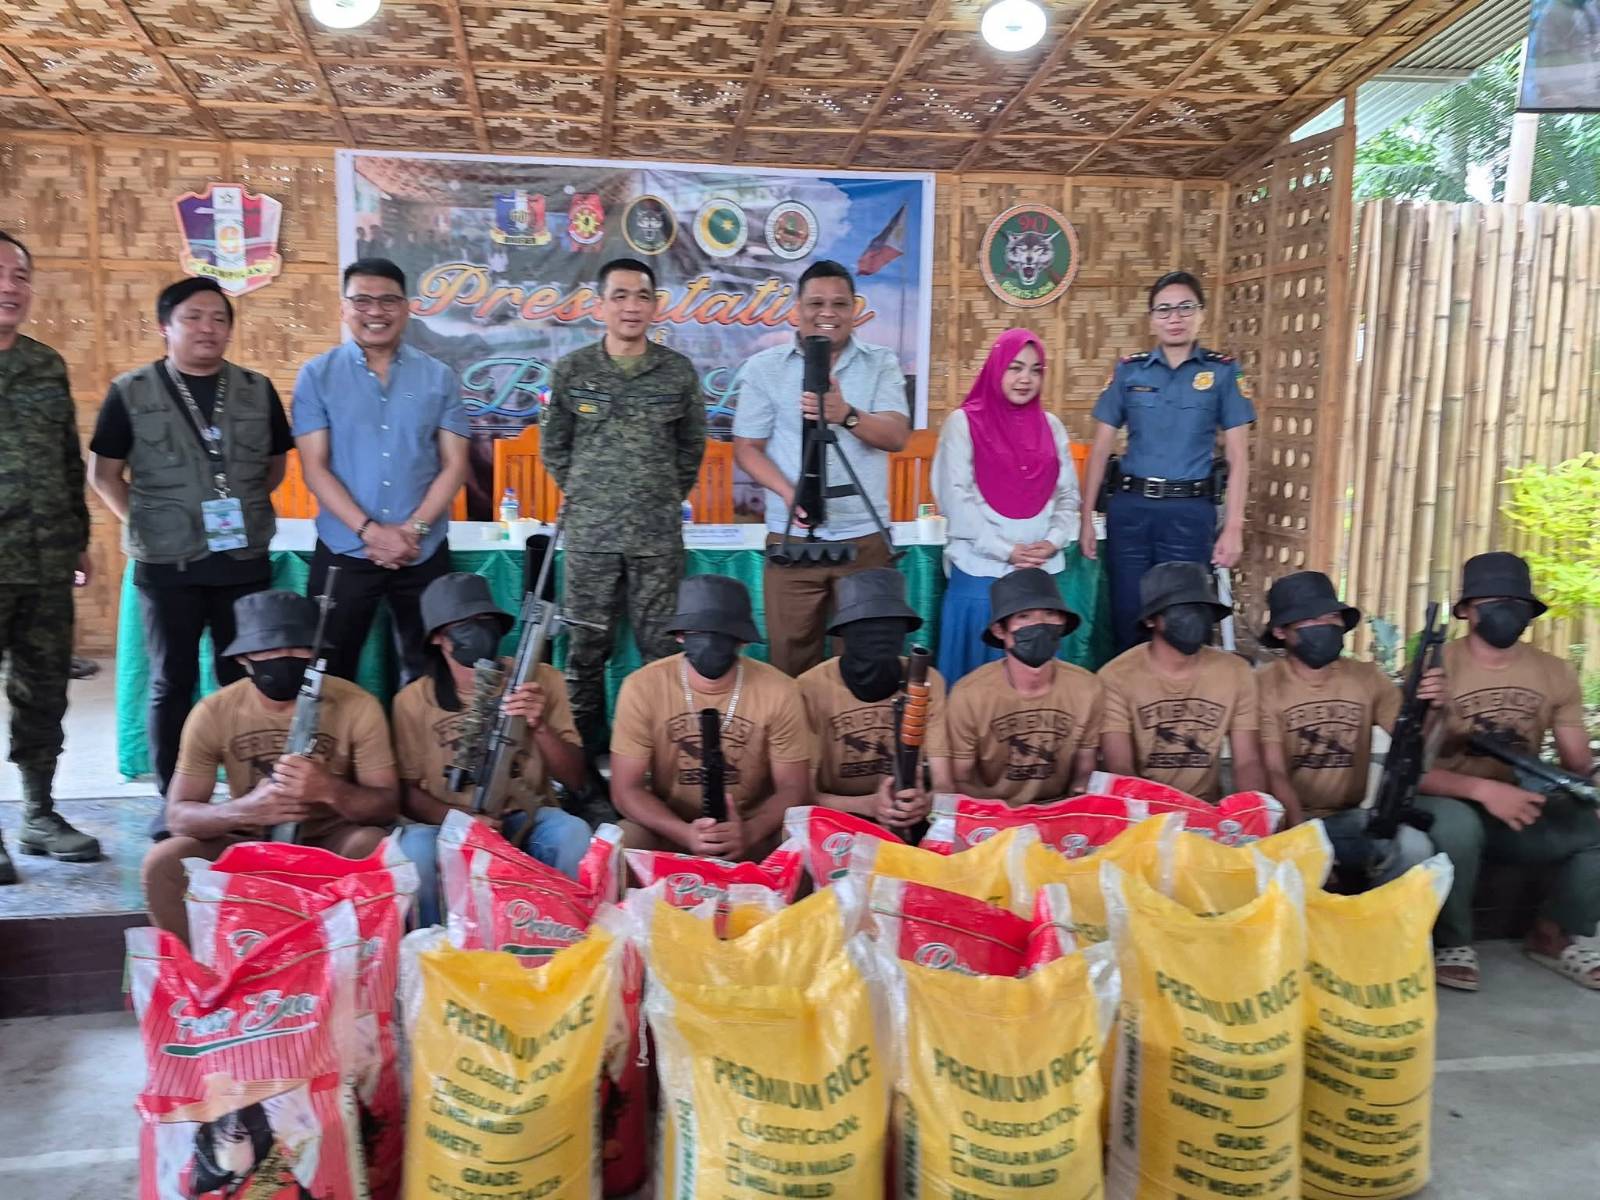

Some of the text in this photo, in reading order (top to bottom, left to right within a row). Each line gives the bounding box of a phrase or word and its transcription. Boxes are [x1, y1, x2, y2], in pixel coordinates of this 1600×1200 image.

[993, 712, 1070, 740] FRIENDS
[1142, 703, 1223, 727] FRIENDS
[1287, 704, 1362, 728] FRIENDS
[1156, 970, 1300, 1026] PREMIUM RICE
[1183, 1027, 1291, 1055] CLASSIFICATION:
[712, 1045, 871, 1111] PREMIUM RICE
[934, 1035, 1097, 1103] PREMIUM RICE
[737, 1115, 861, 1145] CLASSIFICATION:
[962, 1104, 1082, 1138] CLASSIFICATION:
[969, 1142, 1030, 1166] REGULAR
[970, 1164, 1060, 1188] WELL MILLED
